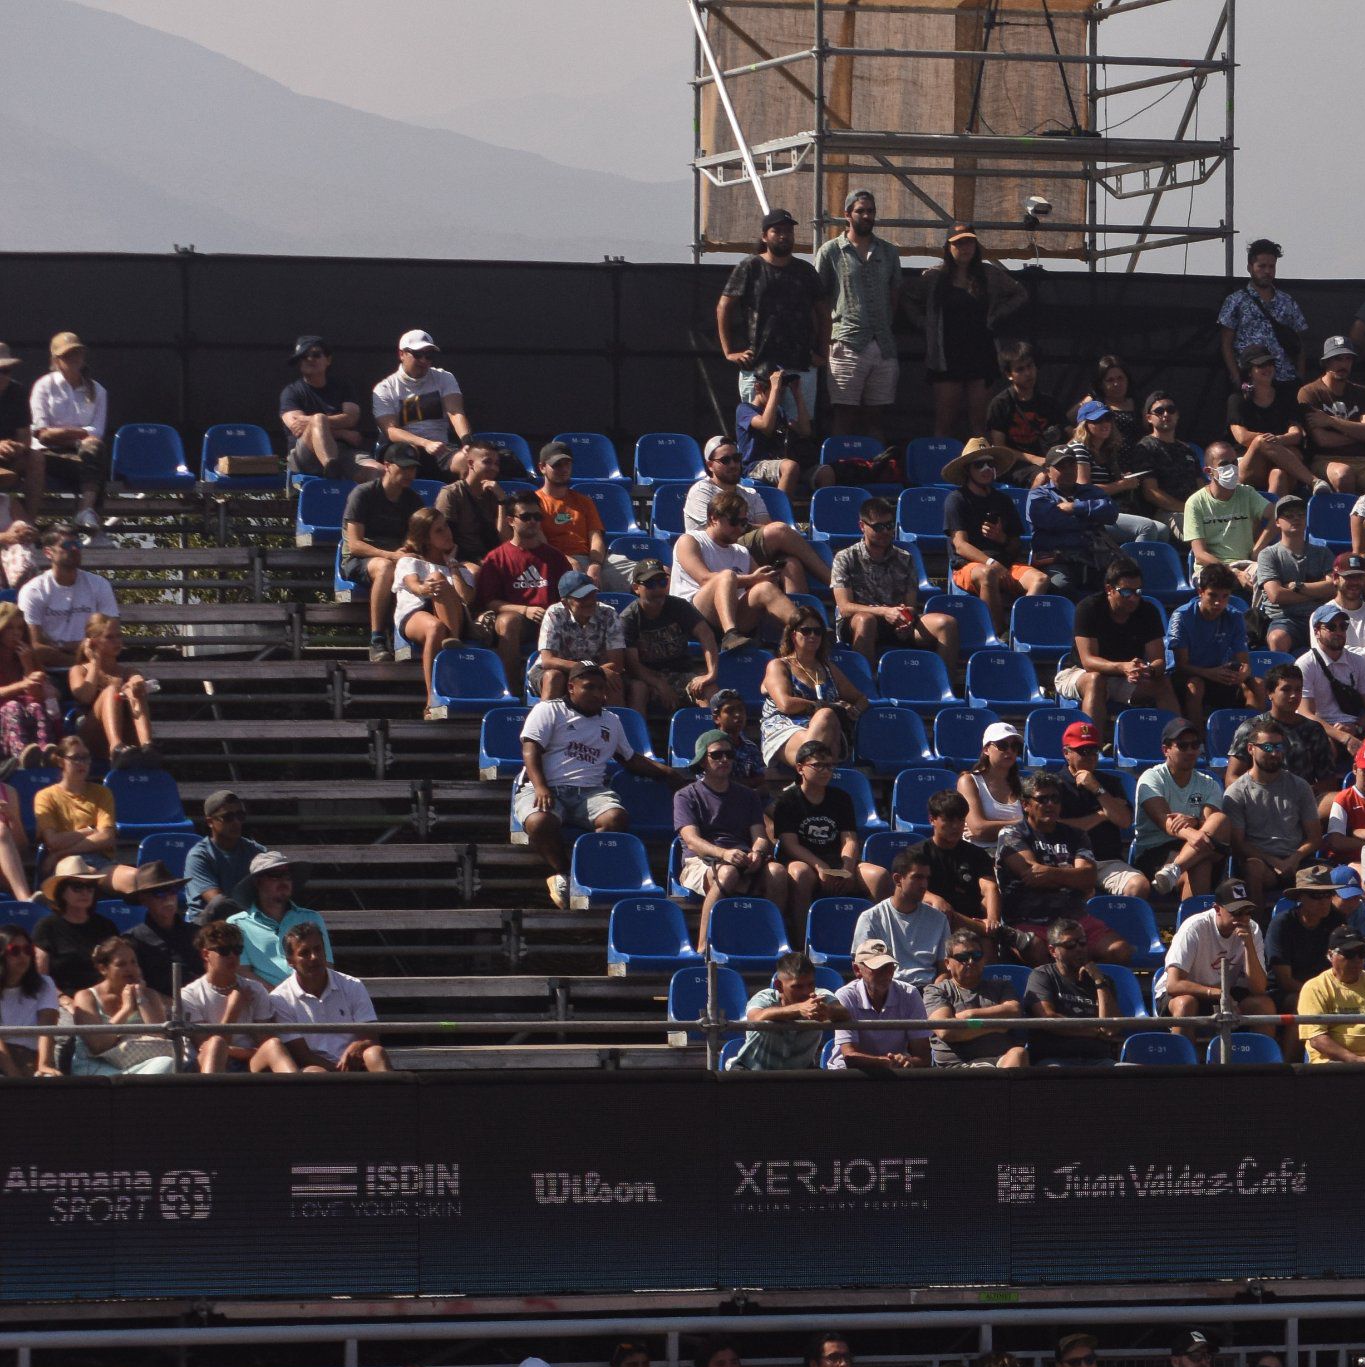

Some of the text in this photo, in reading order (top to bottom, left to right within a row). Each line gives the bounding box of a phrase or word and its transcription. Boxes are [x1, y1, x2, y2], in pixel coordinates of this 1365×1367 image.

[512, 579, 549, 590] adidas
[3, 1166, 152, 1193] Alemana
[366, 1162, 460, 1197] ISDIN
[530, 1170, 658, 1205] Wilson
[733, 1157, 929, 1197] XERJOFF
[49, 1196, 151, 1225] SPORT
